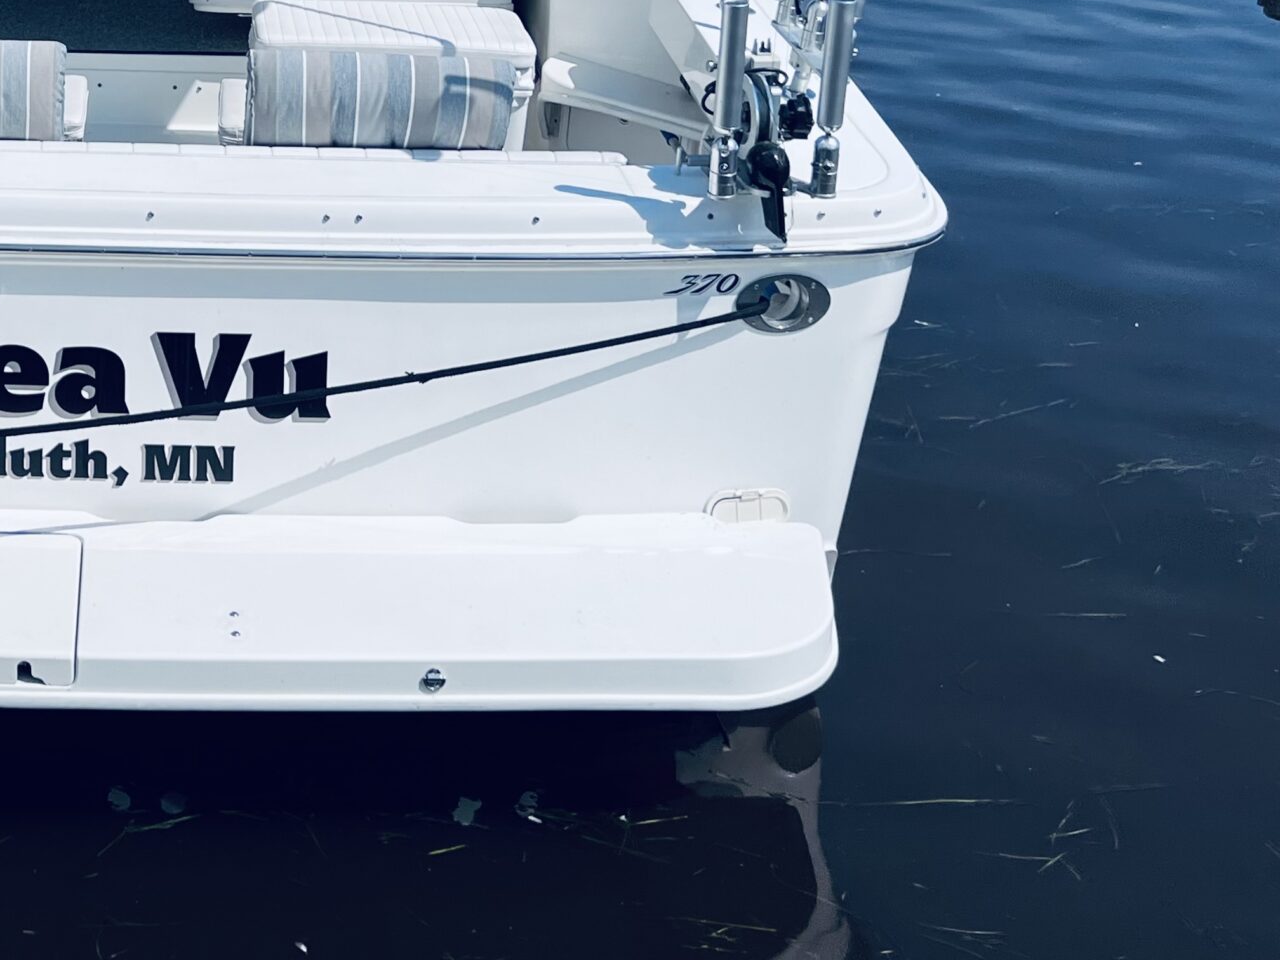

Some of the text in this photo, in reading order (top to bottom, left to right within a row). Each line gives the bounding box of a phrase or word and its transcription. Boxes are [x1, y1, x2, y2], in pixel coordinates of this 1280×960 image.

[663, 273, 741, 296] 370
[150, 331, 332, 422] Vu
[140, 443, 236, 483] MN
